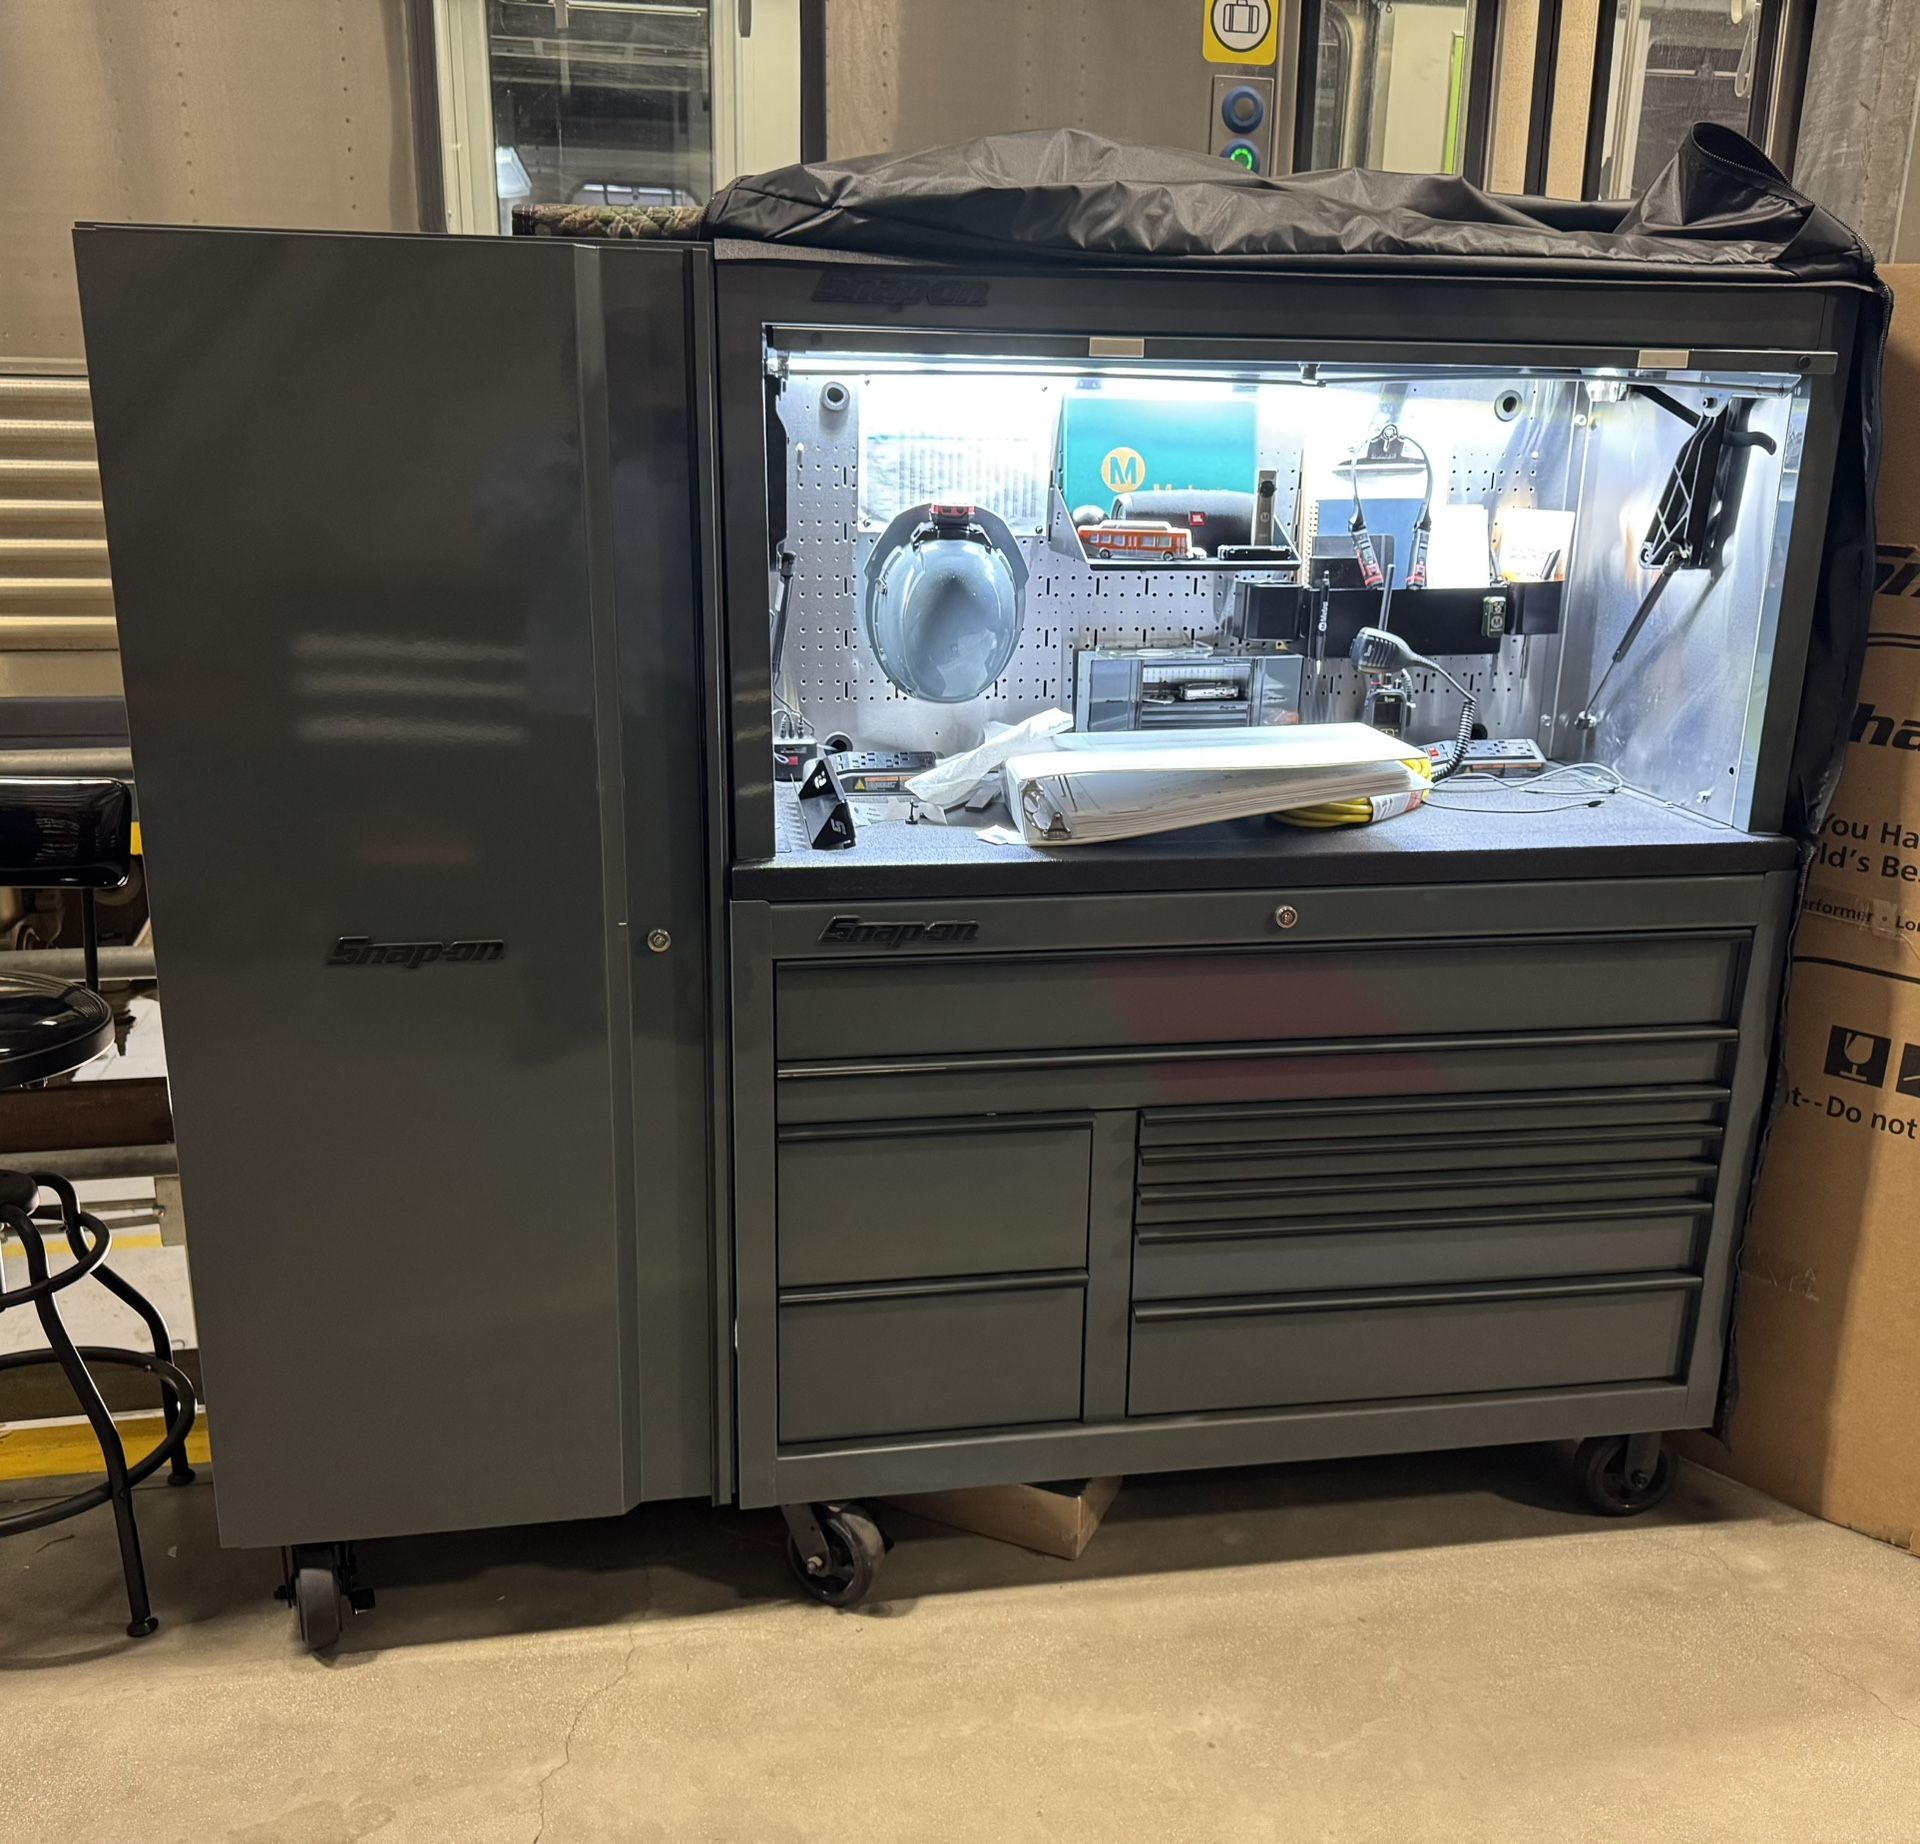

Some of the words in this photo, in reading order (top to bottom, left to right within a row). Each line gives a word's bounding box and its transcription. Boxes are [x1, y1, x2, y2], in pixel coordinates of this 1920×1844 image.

[1817, 842, 1870, 873] ld's
[1881, 855, 1920, 882] Be
[817, 915, 979, 950] Snap-on
[326, 935, 505, 969] Snap-on
[1871, 1112, 1918, 1139] not
